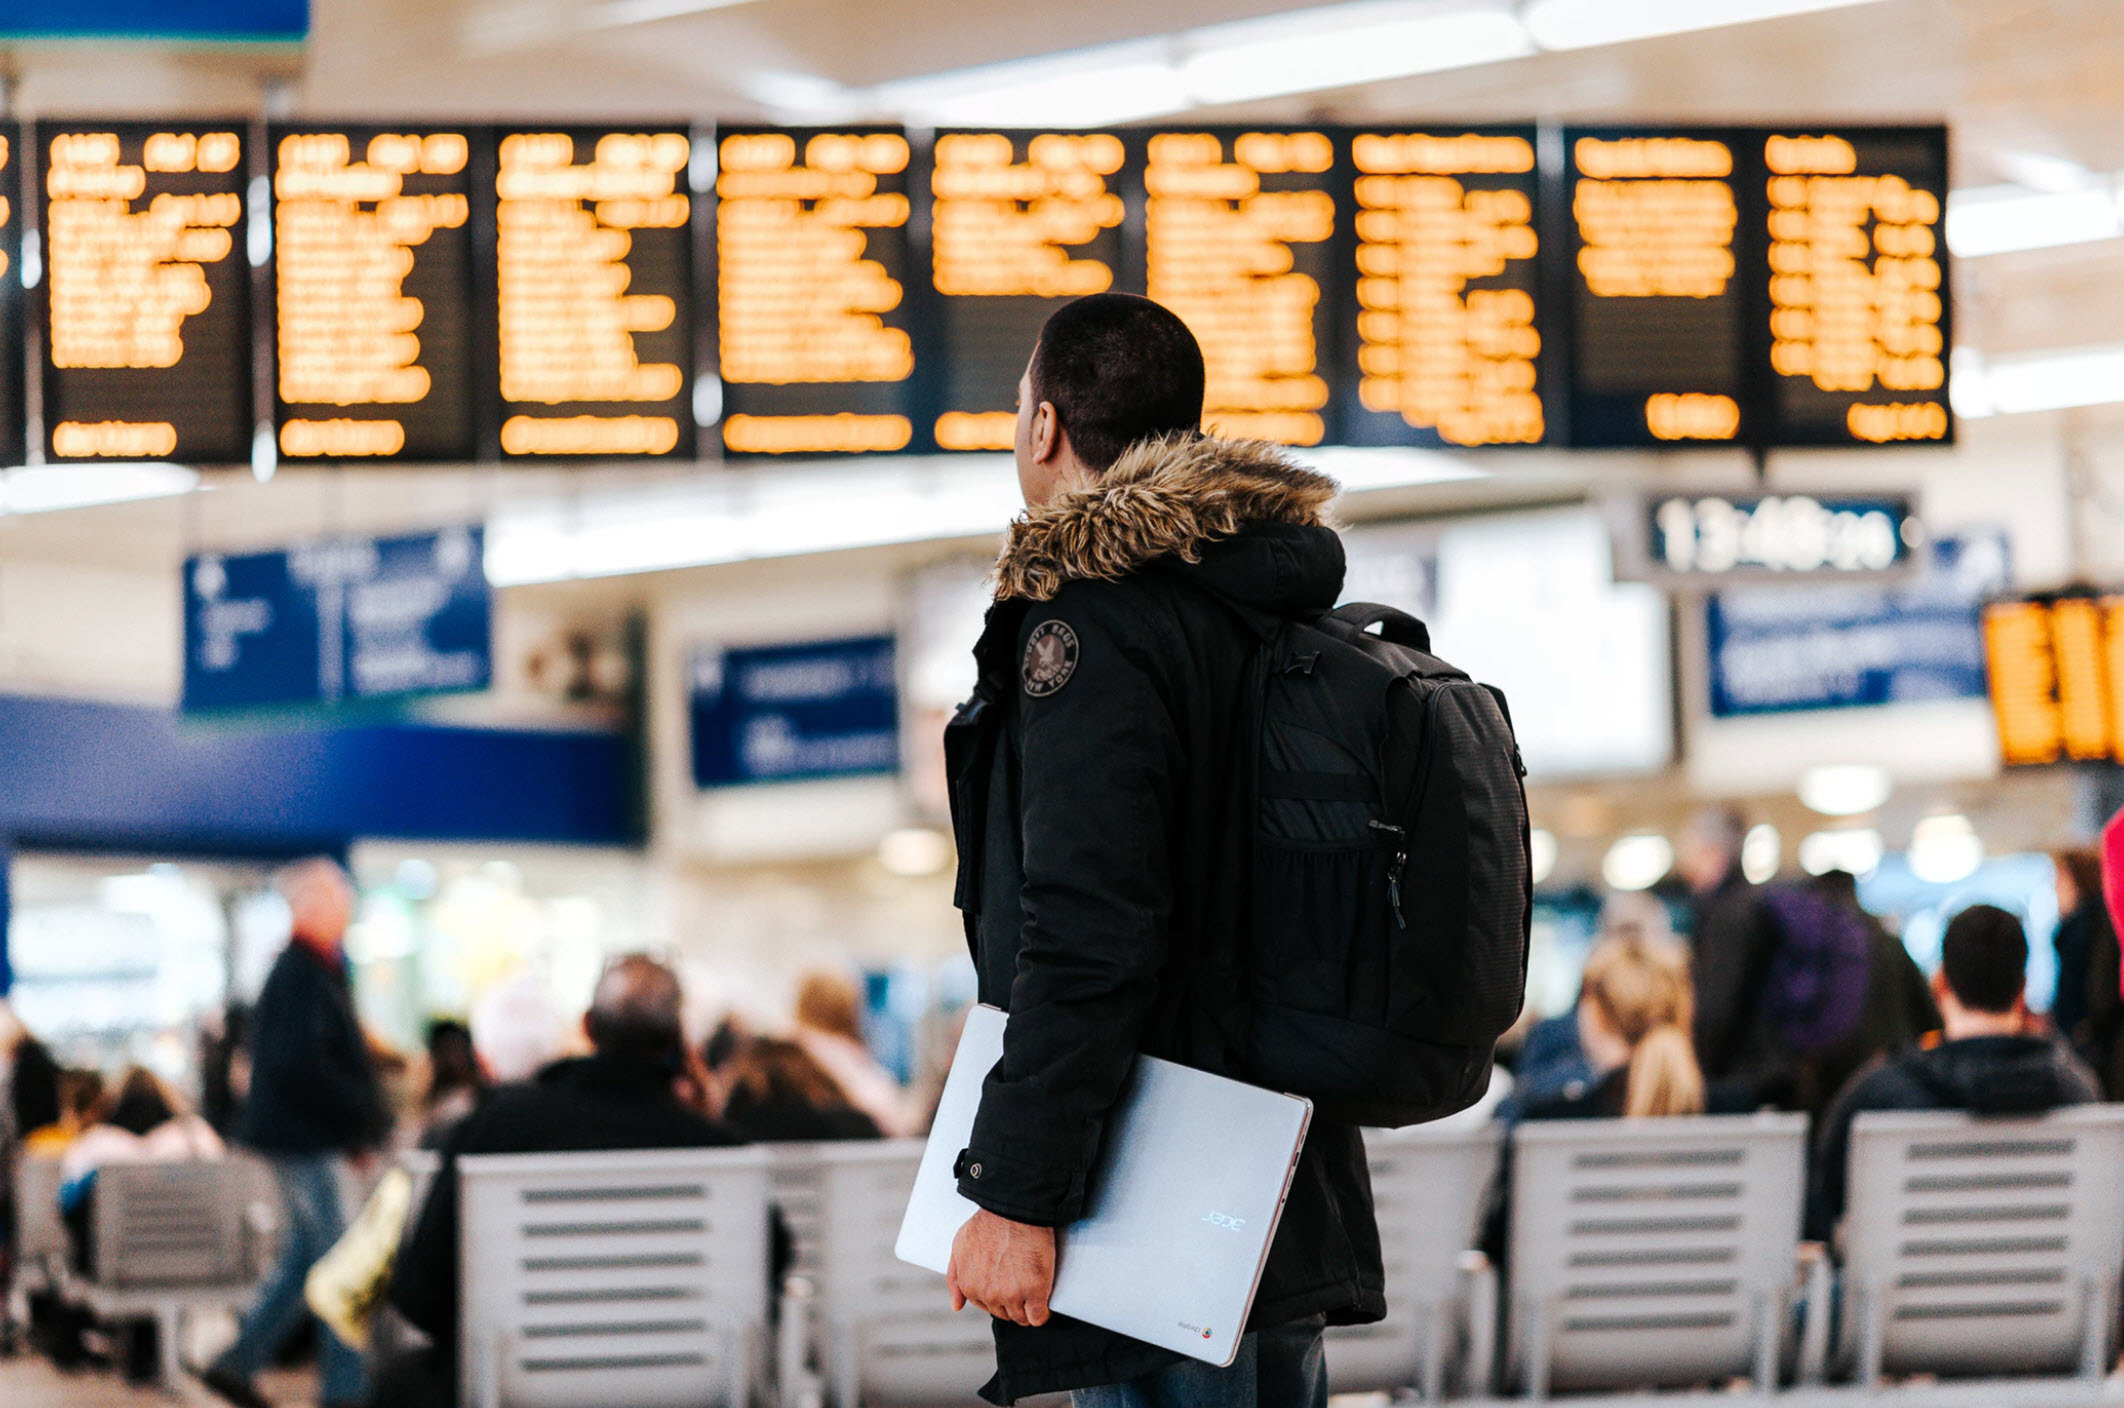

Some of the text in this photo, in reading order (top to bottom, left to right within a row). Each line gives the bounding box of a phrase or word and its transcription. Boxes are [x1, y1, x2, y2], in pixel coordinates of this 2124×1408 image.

[1051, 624, 1075, 649] BROS
[1048, 660, 1073, 688] YORK
[1201, 1209, 1246, 1231] acer
